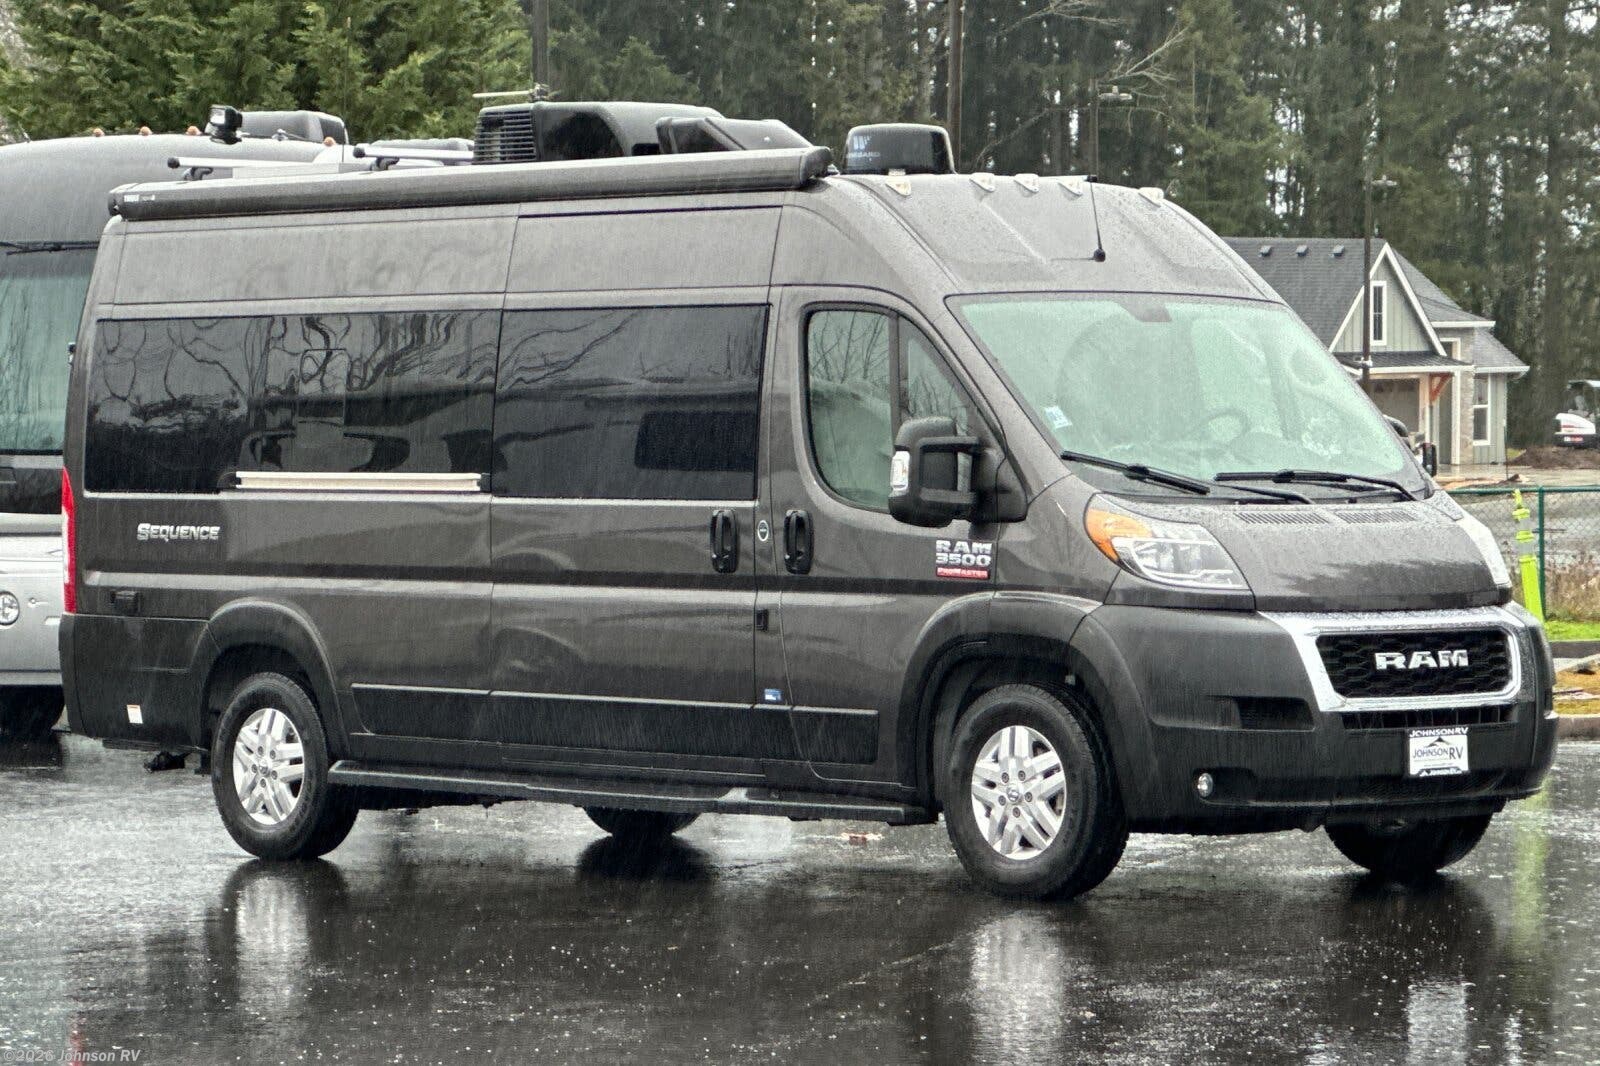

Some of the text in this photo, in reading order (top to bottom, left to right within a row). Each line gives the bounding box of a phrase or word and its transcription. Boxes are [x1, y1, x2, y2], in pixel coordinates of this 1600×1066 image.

[137, 523, 221, 542] SEQUENCE
[935, 540, 993, 554] RAM
[935, 553, 992, 567] 3500
[1374, 649, 1469, 670] RAM
